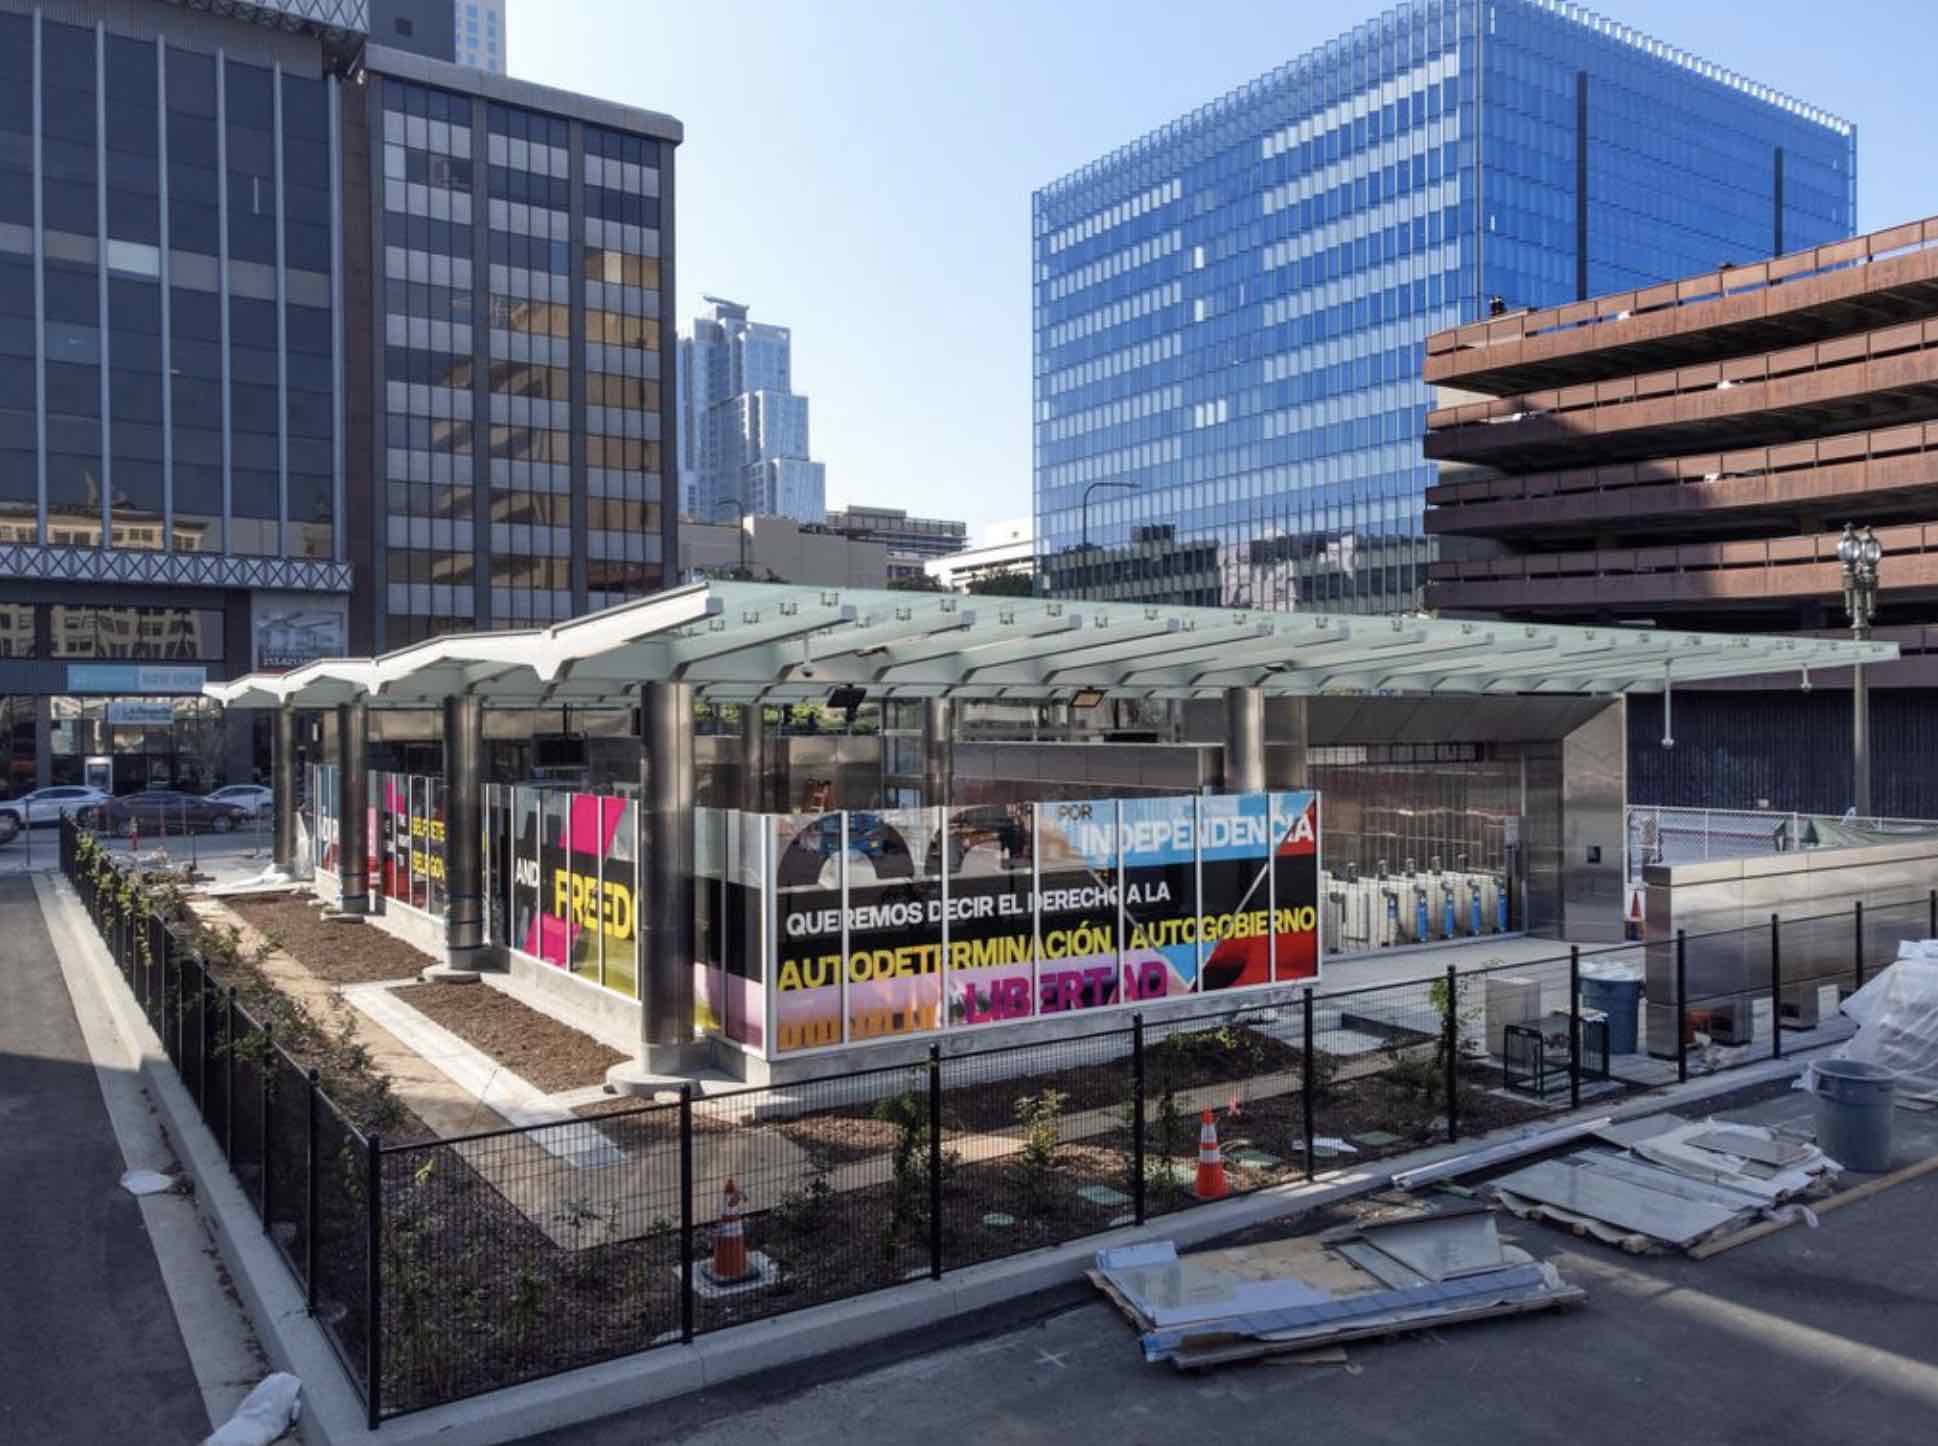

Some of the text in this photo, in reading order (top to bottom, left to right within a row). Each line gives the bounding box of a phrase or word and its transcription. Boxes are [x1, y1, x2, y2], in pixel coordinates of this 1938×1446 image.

[1081, 812, 1315, 858] INDEPENDENCIA
[514, 857, 540, 887] AND
[786, 903, 922, 936] QUEREMOS
[928, 895, 994, 922] DECIR
[998, 894, 1023, 914] EL
[1126, 883, 1143, 905] A
[1145, 881, 1171, 903] LA
[1129, 906, 1316, 950] AUTOGOBIERNO
[965, 960, 1168, 1024] LIBERTAD
